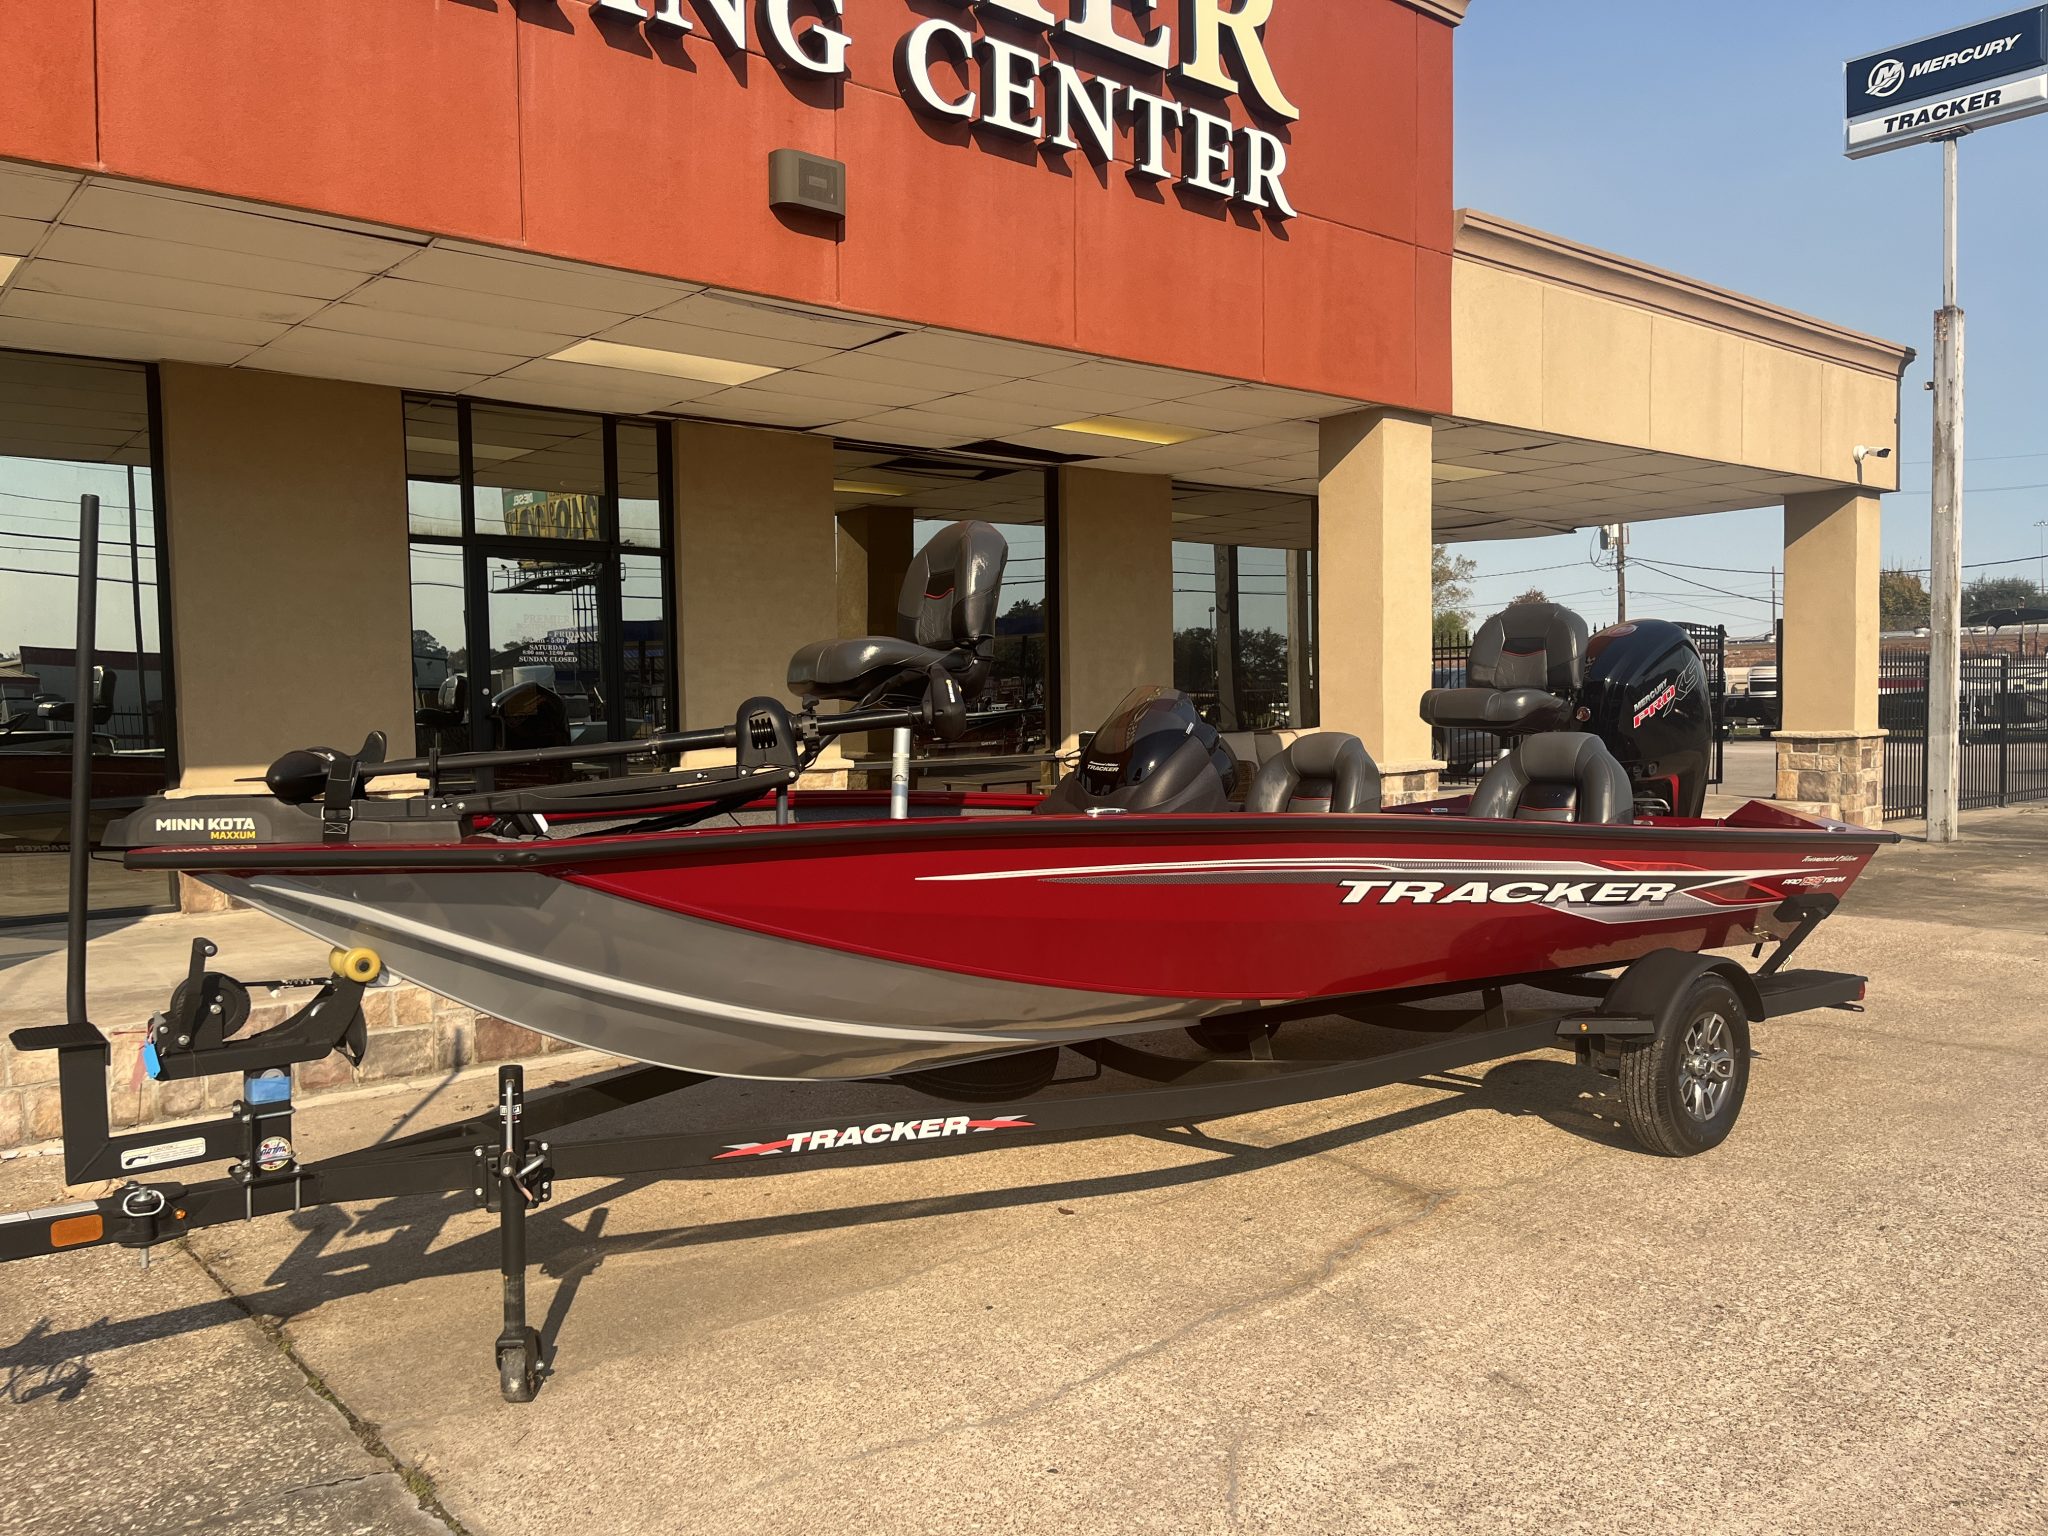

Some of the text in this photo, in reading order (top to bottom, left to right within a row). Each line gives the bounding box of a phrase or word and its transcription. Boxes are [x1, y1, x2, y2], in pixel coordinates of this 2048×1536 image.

[1908, 33, 2022, 79] MERCURY
[908, 18, 1298, 218] CENTER
[1883, 89, 2002, 133] TRACKER
[1633, 684, 1676, 729] PRO
[1634, 678, 1668, 712] MERCURY
[1087, 764, 1120, 773] TRACKER
[155, 817, 256, 831] MINN KOTA
[210, 830, 256, 840] MAXXUM
[1339, 879, 1677, 905] TRACKER
[786, 1115, 970, 1153] TRACKER
